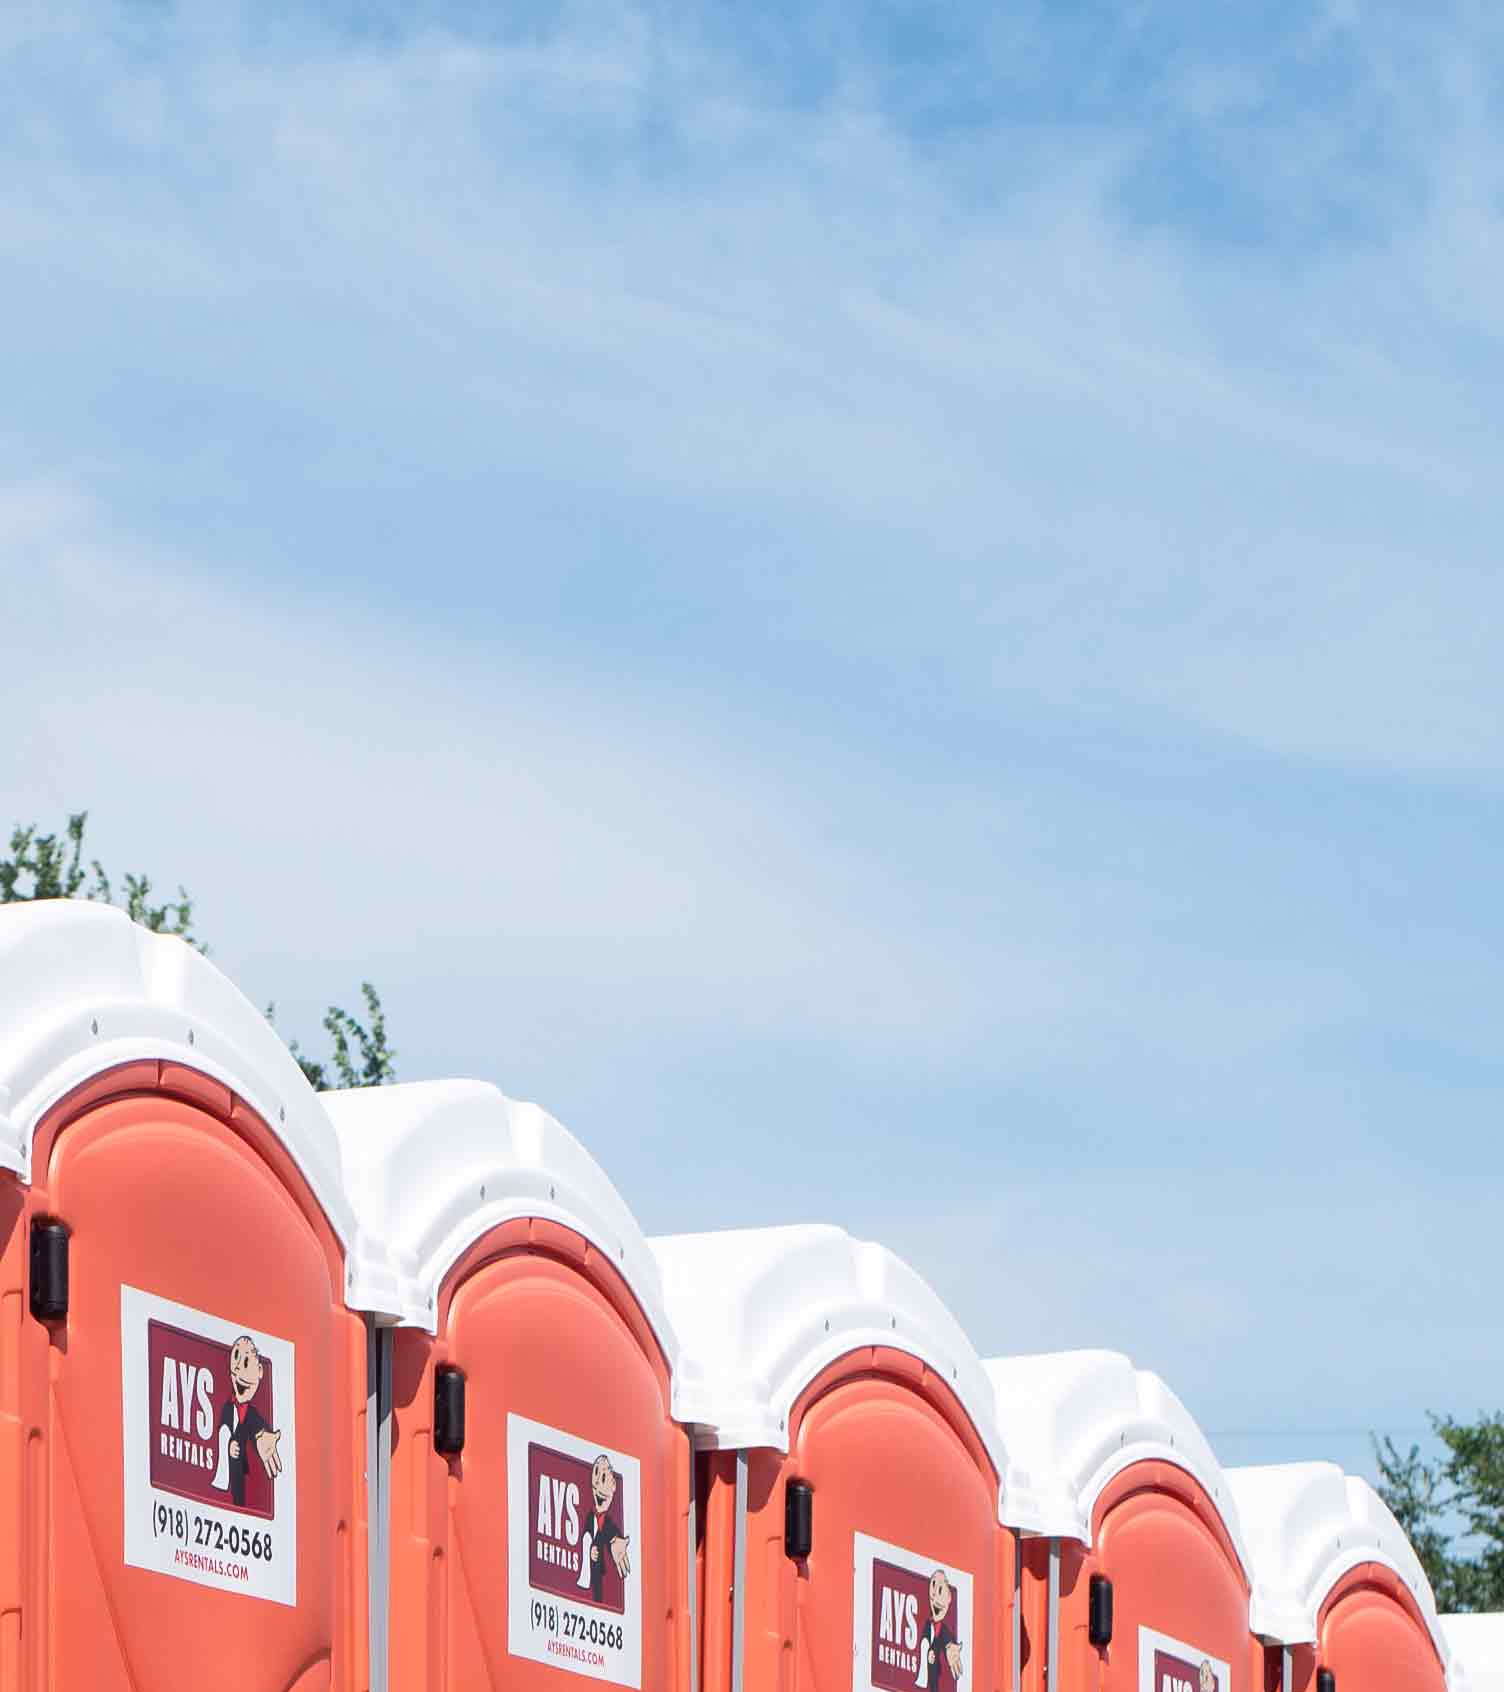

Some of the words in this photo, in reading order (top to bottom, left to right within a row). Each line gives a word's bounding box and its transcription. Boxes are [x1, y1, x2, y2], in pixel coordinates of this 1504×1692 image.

[160, 1356, 214, 1441] AYS
[160, 1432, 214, 1471] RENTALS
[153, 1500, 189, 1547] (918)
[194, 1516, 272, 1562] 272-0568
[537, 1474, 580, 1546] AYS
[174, 1548, 249, 1581] AYSRENTALS.COM
[536, 1540, 579, 1572] RENTALS
[530, 1600, 559, 1637] (918)
[563, 1611, 623, 1651] 272-0568
[880, 1586, 918, 1650] AYS
[547, 1639, 605, 1666] AYSRENTALS.COM
[878, 1644, 917, 1673] RENTALS
